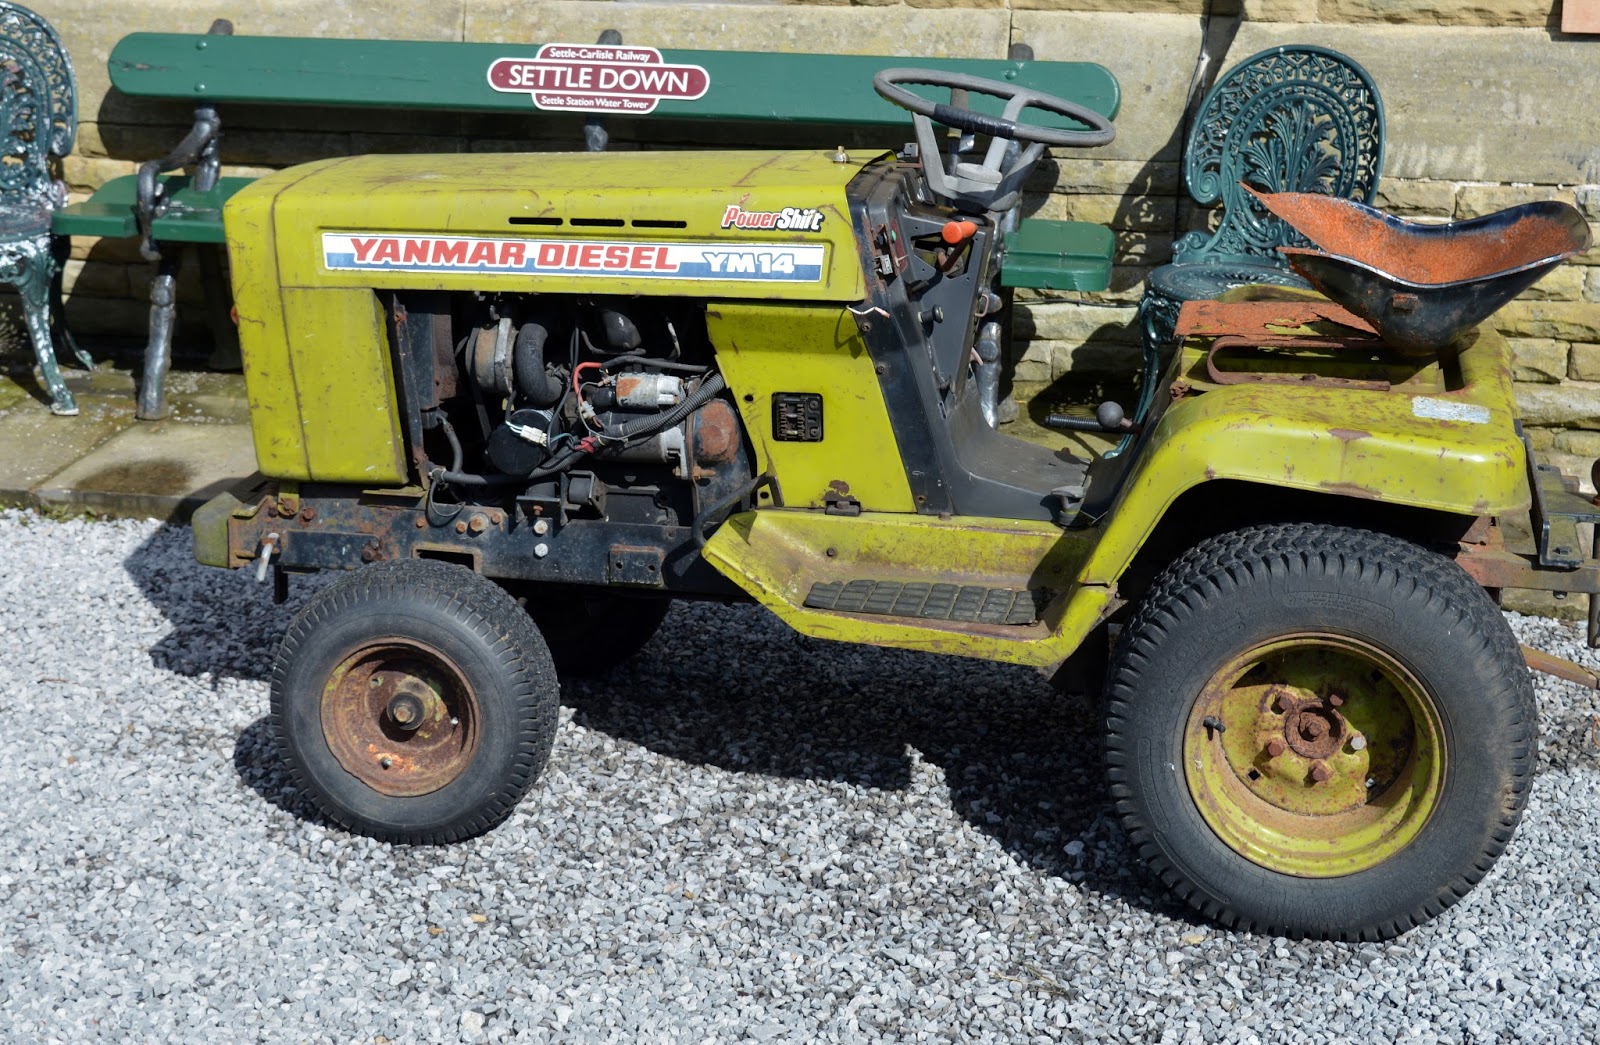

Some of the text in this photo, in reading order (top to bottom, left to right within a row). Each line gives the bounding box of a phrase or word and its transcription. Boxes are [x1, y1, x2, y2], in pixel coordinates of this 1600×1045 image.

[549, 47, 651, 63] Settle-Carlisle Railway
[508, 64, 689, 93] SETTLE DOWN
[541, 95, 649, 109] Settle Station Water Tower
[721, 204, 824, 231] PowerShift
[350, 238, 795, 274] YANMAR DIESEL YM14
